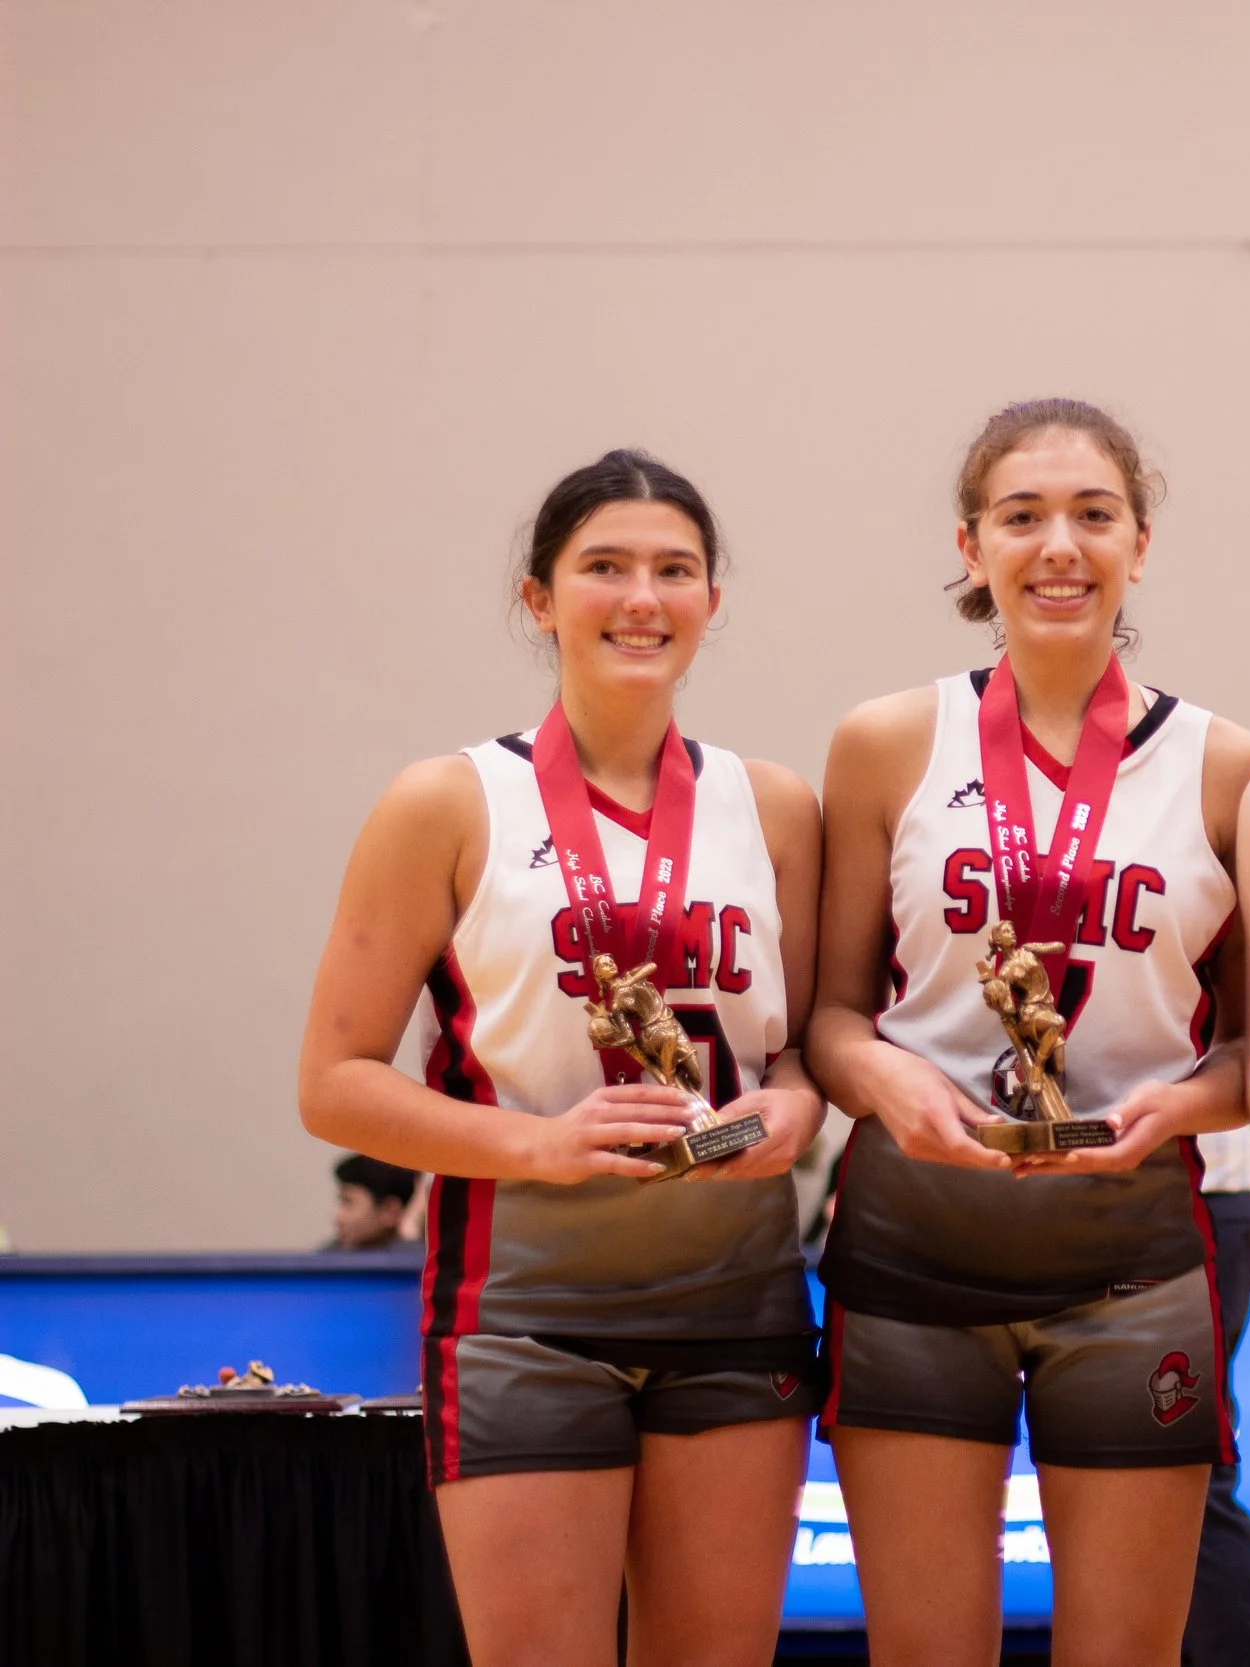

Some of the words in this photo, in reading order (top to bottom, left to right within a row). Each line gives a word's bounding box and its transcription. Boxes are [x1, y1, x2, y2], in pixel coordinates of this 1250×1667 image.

[1013, 825, 1027, 845] BC
[1062, 837, 1080, 870] Place
[658, 857, 673, 884] 2023
[589, 874, 605, 895] BC
[651, 891, 666, 925] Place
